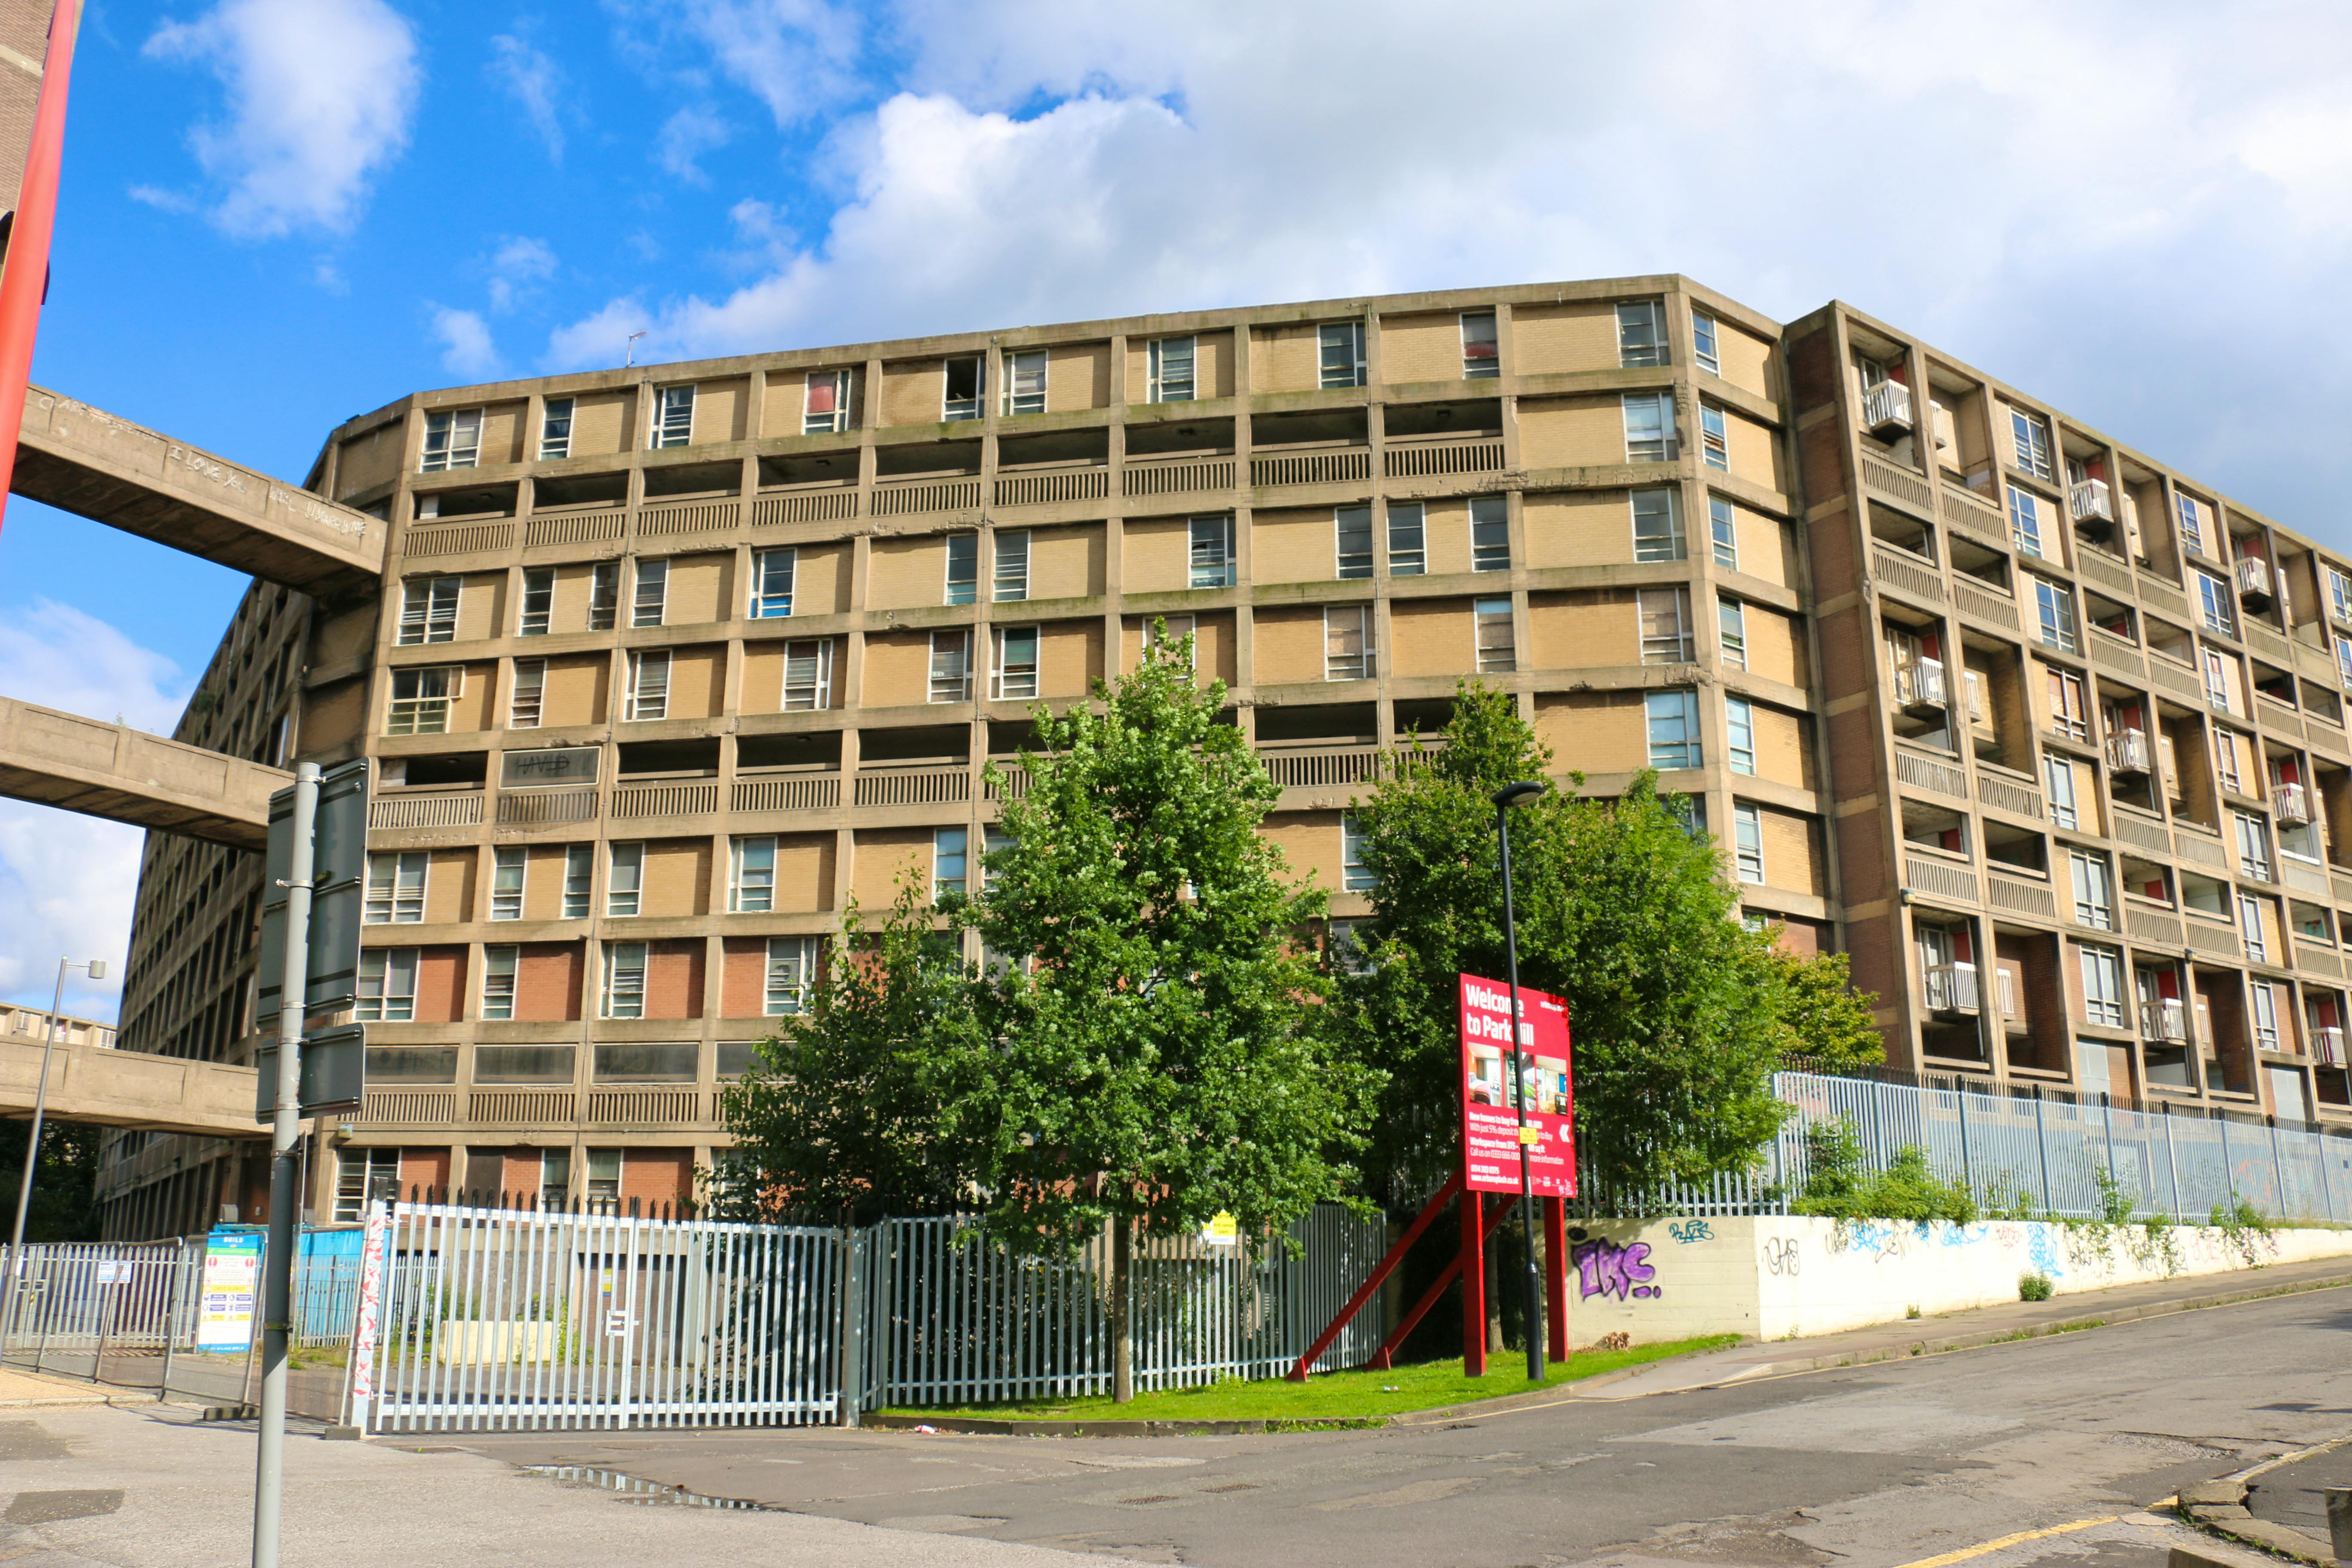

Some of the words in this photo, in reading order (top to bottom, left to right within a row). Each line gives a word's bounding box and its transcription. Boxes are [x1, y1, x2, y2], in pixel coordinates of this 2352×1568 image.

[186, 451, 221, 483] LOVE
[1467, 1012, 1481, 1036] to
[1483, 1015, 1513, 1042] Park
[1469, 1112, 1480, 1121] New
[1480, 1113, 1496, 1124] homes
[1496, 1115, 1501, 1124] to
[1501, 1116, 1510, 1127] buy
[1470, 1122, 1480, 1132] With
[1480, 1123, 1489, 1134] just
[1489, 1124, 1498, 1134] 5%
[1498, 1126, 1514, 1137] deposit
[1540, 1132, 1545, 1140] to
[1545, 1132, 1553, 1142] Buy
[1470, 1136, 1495, 1148] Workspace
[1495, 1139, 1507, 1149] from
[1470, 1147, 1479, 1156] Call
[1511, 1152, 1521, 1161] 000
[1541, 1155, 1564, 1165] information
